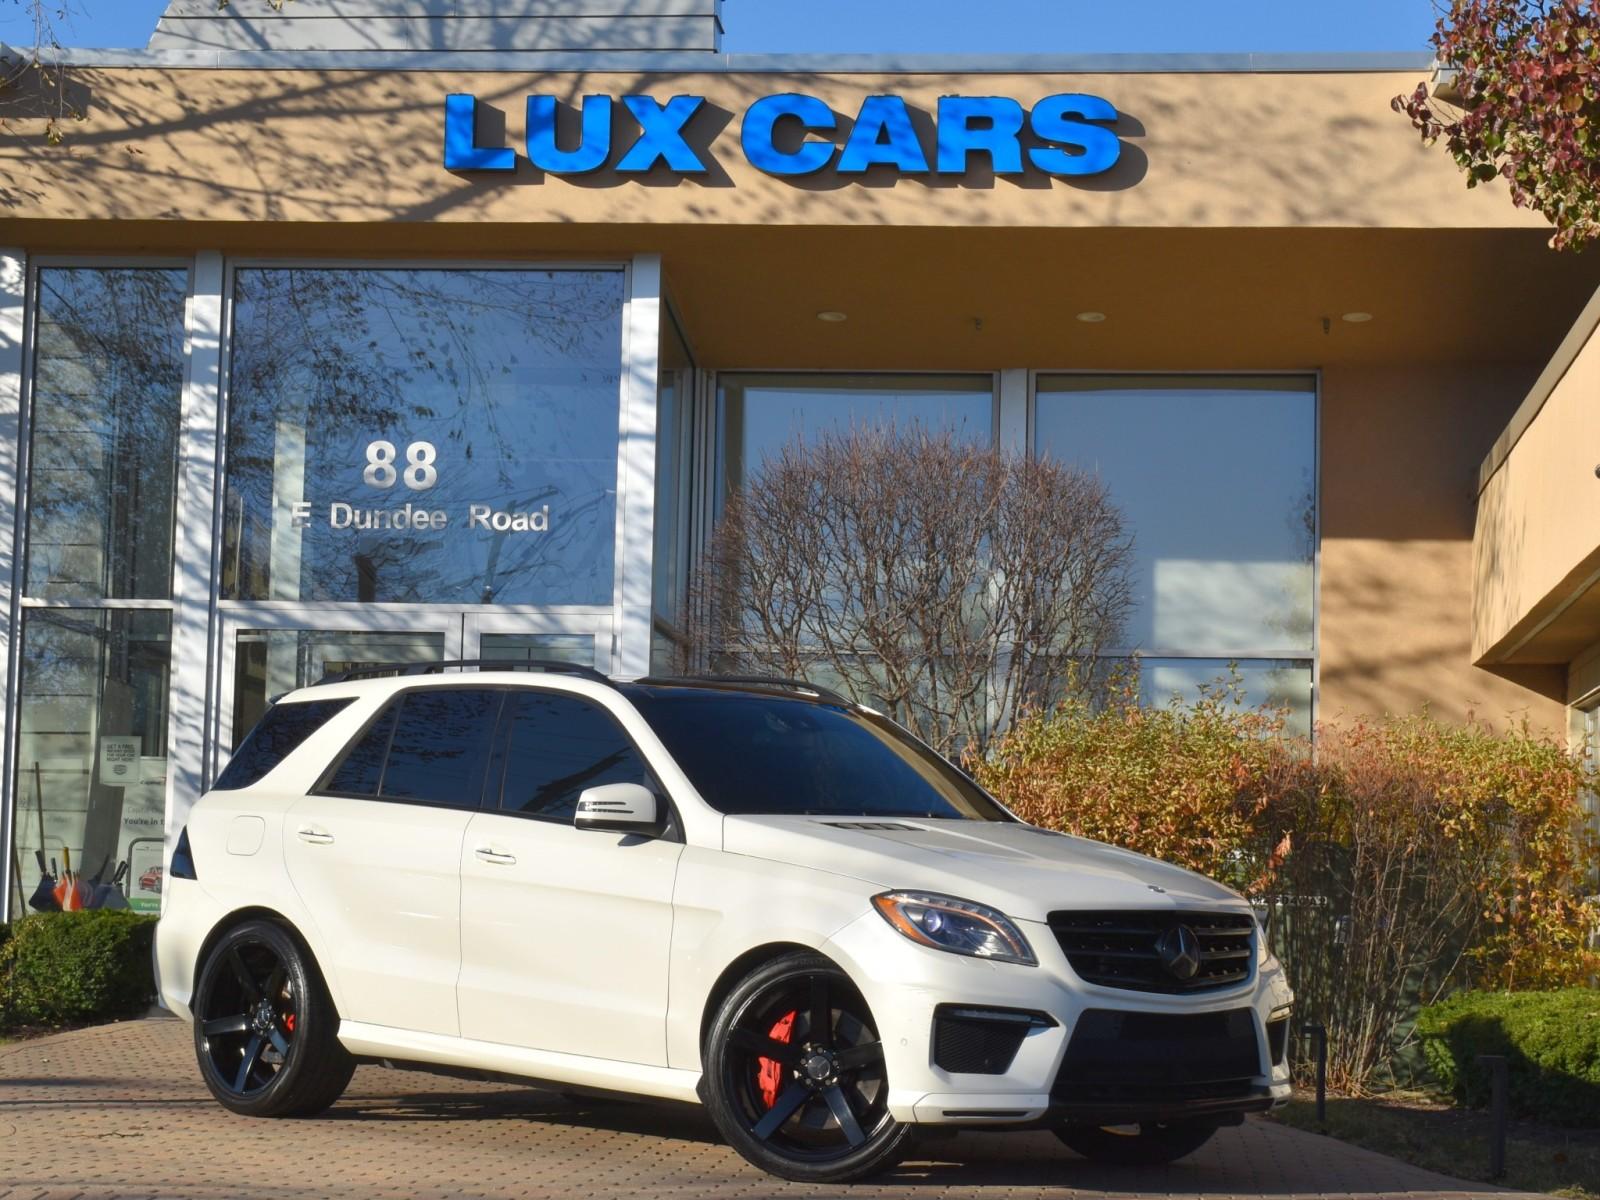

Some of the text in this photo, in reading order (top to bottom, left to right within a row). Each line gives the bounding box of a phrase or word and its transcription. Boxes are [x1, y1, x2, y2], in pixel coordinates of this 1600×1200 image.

[443, 93, 1121, 177] LUX CARS
[363, 440, 438, 491] 88
[291, 501, 549, 532] E Dundee Road
[124, 817, 148, 825] You're
[150, 817, 158, 825] in
